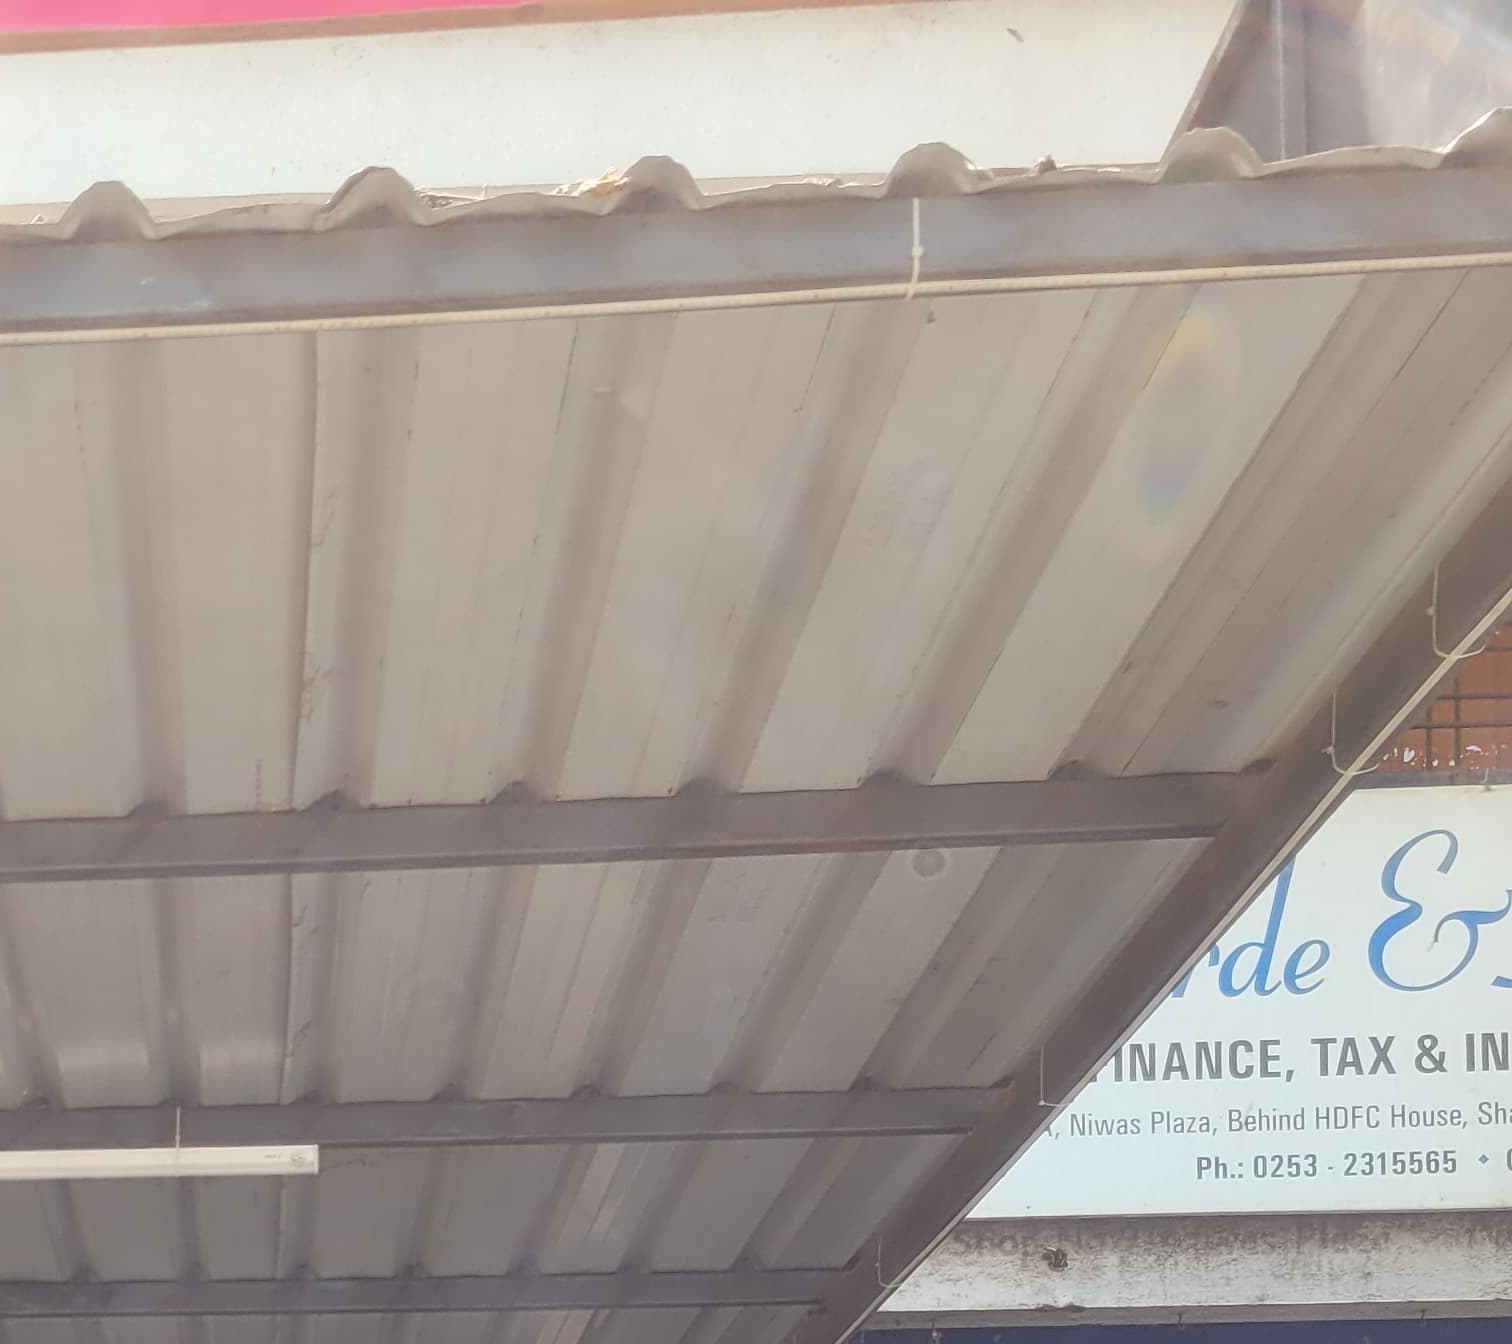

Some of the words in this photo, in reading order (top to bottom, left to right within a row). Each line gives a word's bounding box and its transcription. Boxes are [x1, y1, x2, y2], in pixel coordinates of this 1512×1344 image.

[1090, 1039, 1294, 1084] INANCE,
[1310, 1036, 1397, 1077] TAX
[1414, 1034, 1449, 1075] &
[1070, 1112, 1141, 1137] Niwas
[1151, 1110, 1218, 1136] Plaza,
[1228, 1106, 1305, 1132] Behind
[1315, 1105, 1380, 1130] HDFC
[1390, 1104, 1468, 1130] House,
[1478, 1101, 1512, 1126] Sh
[1196, 1156, 1244, 1180] Ph.:
[1253, 1153, 1318, 1178] 0253
[1343, 1150, 1458, 1177] 2315565
